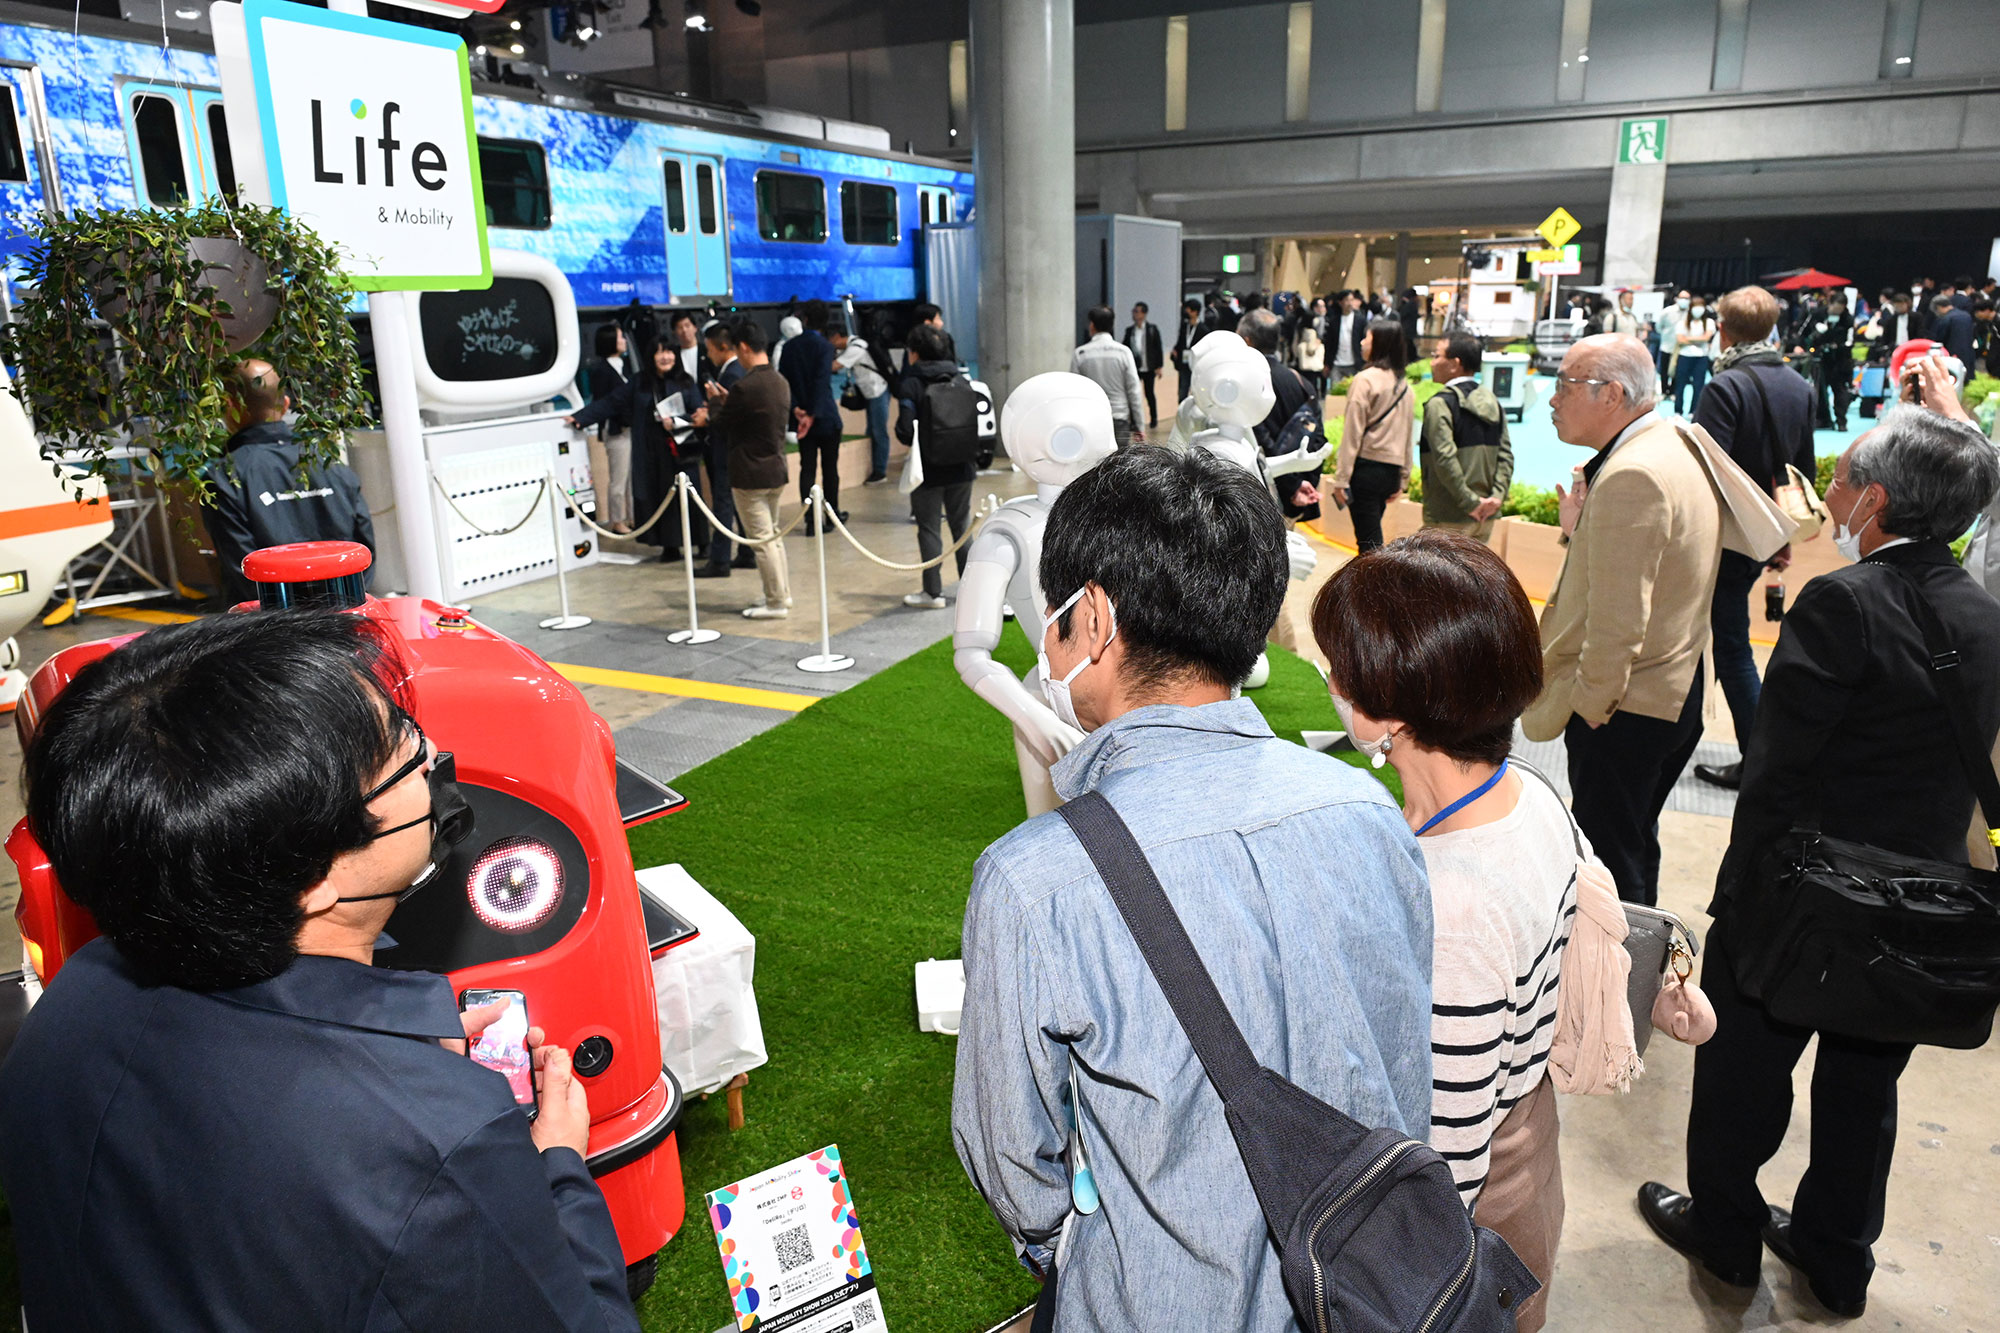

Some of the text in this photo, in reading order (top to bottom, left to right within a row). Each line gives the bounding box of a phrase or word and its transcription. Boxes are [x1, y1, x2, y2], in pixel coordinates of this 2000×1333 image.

[311, 98, 447, 191] Life
[378, 206, 453, 230] & Mobility
[1553, 219, 1566, 236] P
[759, 1320, 777, 1333] JAPAN
[777, 1309, 803, 1326] MOBILITY
[803, 1302, 820, 1314] SHOW
[820, 1294, 833, 1306] 2023
[834, 1283, 859, 1300] 公式アプリ
